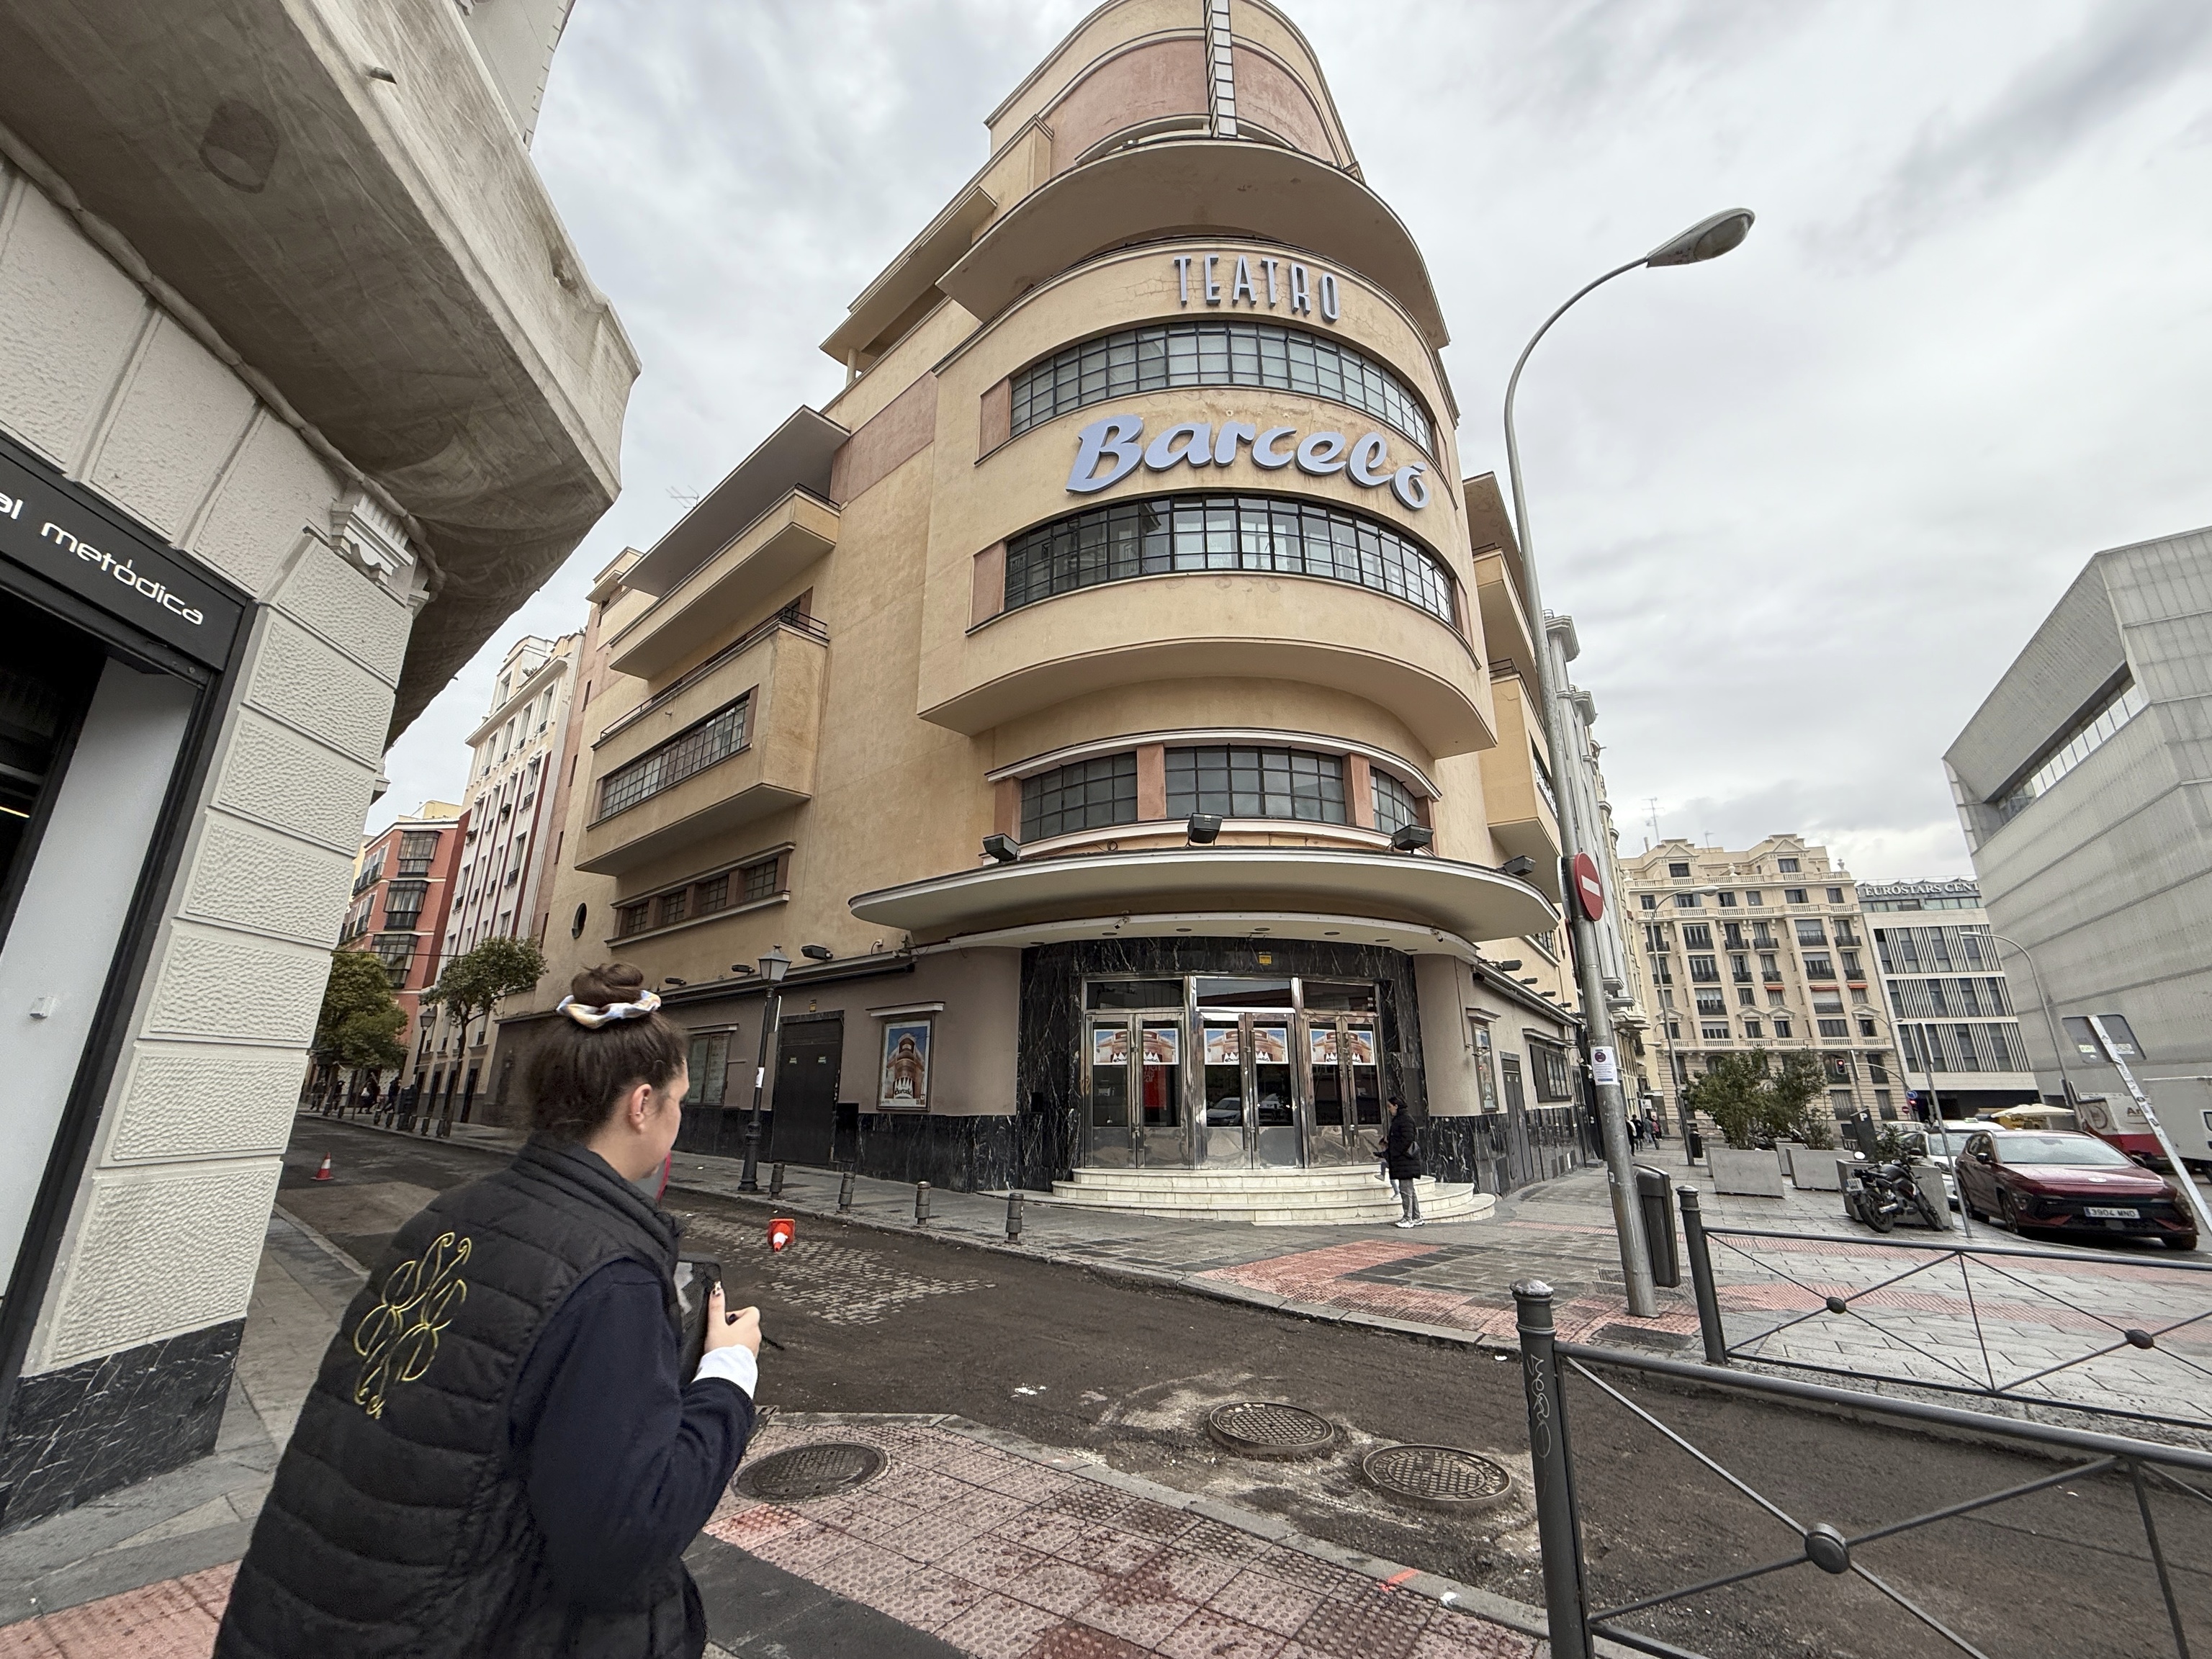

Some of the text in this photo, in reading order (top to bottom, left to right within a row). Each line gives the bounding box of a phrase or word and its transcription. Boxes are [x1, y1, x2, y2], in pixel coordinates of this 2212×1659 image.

[1173, 253, 1340, 323] TEATRO
[1066, 413, 1431, 511] Barceló
[1865, 884, 1942, 897] EUROSTARS
[1859, 1112, 1868, 1122] P
